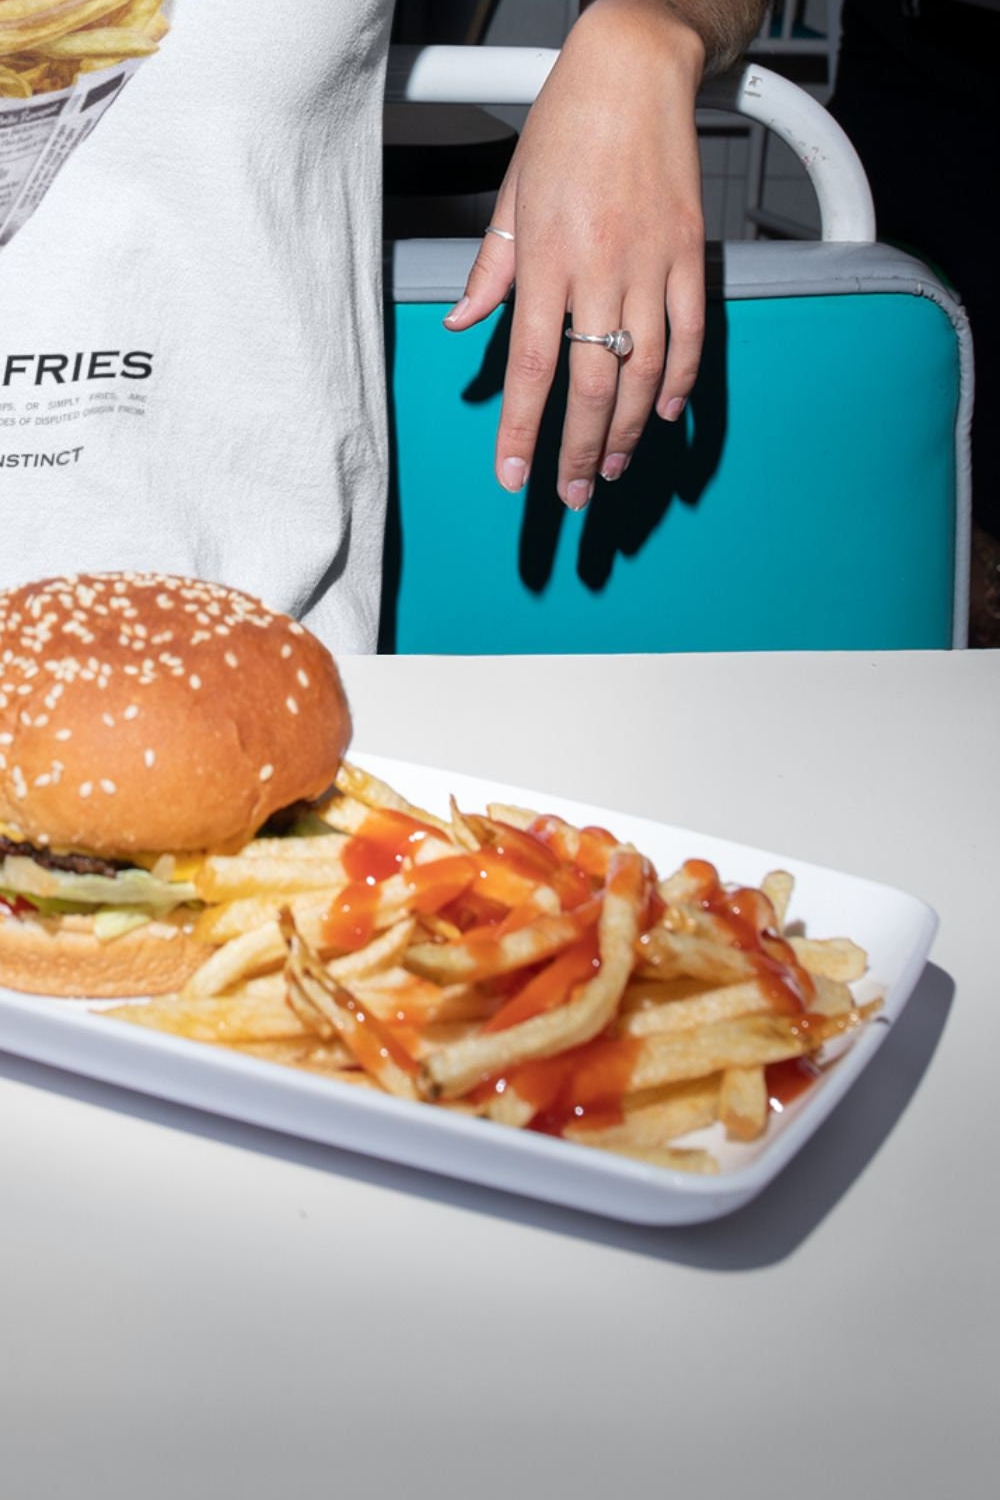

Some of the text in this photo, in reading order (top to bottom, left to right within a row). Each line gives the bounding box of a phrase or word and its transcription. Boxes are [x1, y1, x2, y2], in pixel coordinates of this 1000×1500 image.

[2, 350, 154, 386] FRIES
[25, 402, 39, 411] OR
[48, 397, 80, 410] SIMPLY
[128, 393, 147, 404] ARE
[19, 417, 33, 426] OF
[35, 411, 80, 426] DISPUTED
[118, 405, 145, 416] FROM
